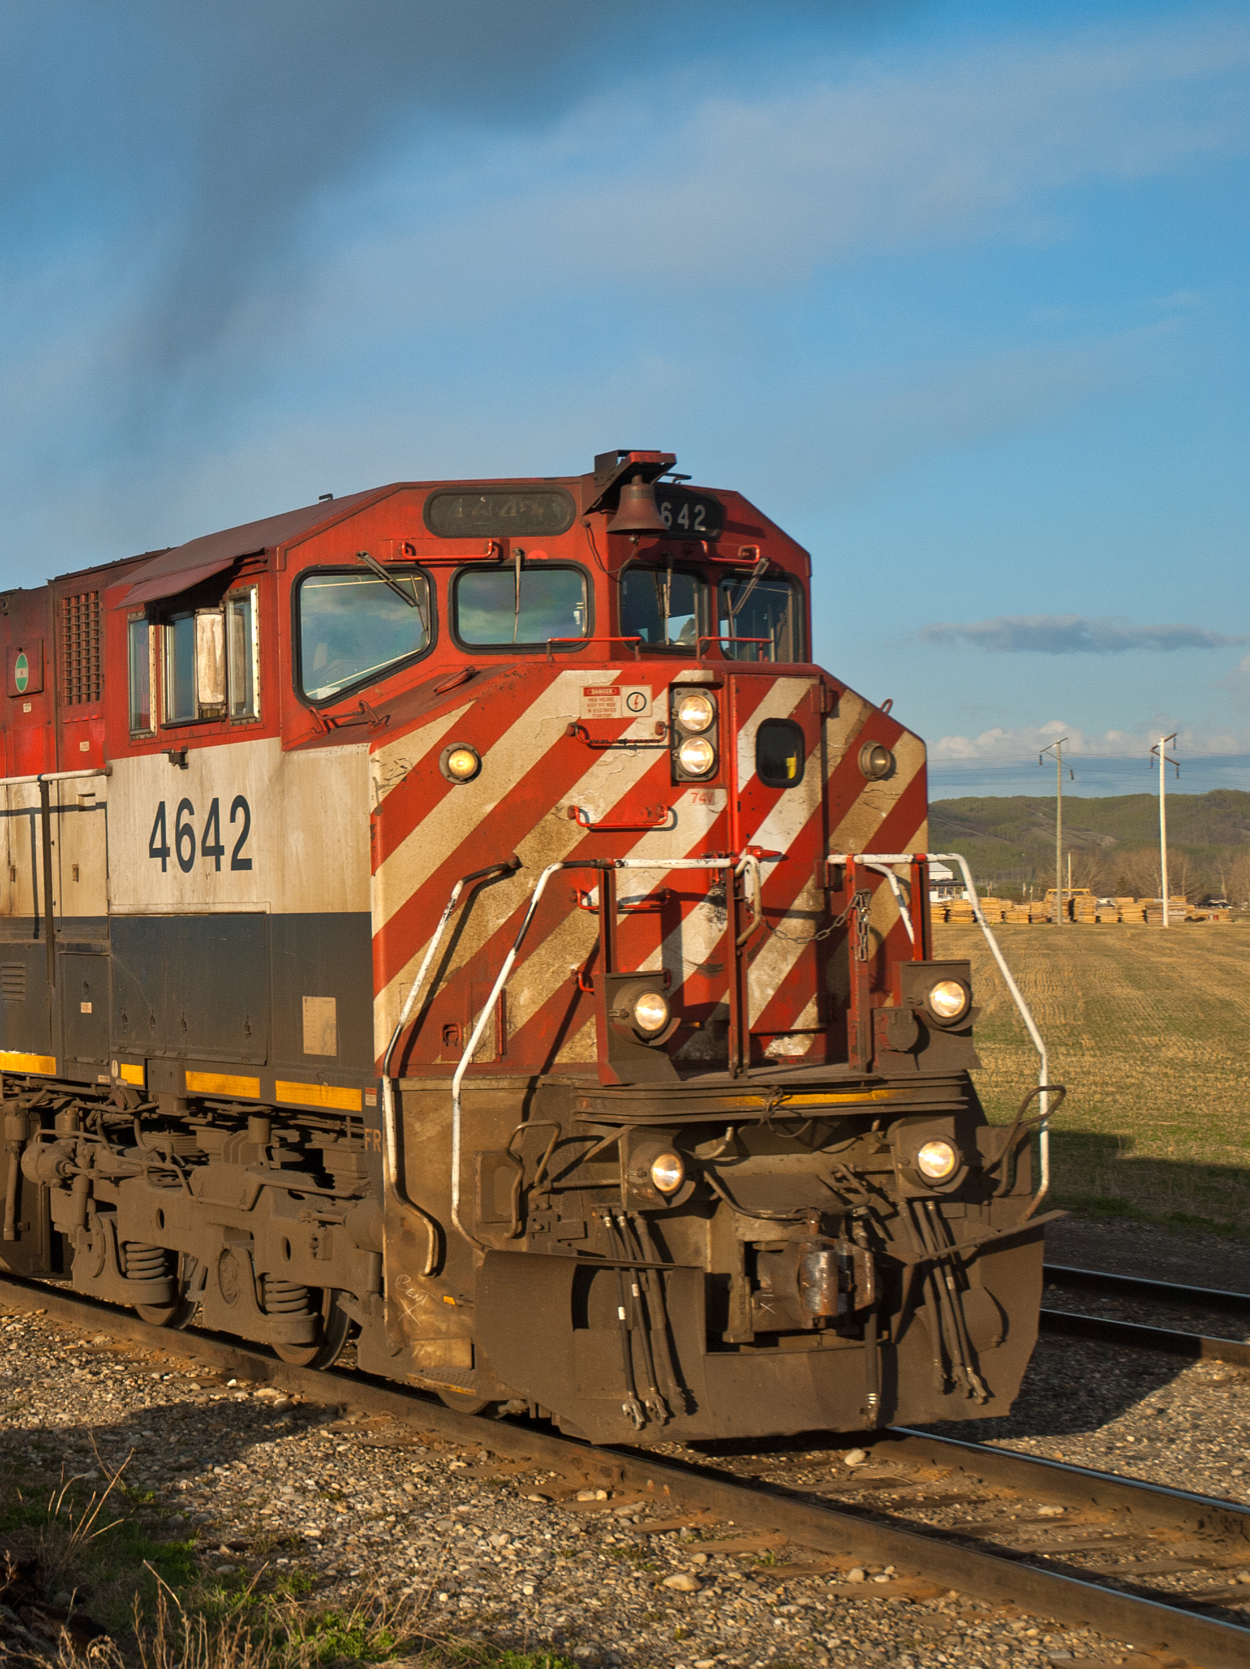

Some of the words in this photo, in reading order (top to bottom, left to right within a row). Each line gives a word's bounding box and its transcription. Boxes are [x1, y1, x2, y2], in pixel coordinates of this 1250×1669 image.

[659, 501, 707, 532] 642
[690, 792, 714, 804] 74V
[148, 794, 253, 874] 4642
[364, 1128, 382, 1153] FR
